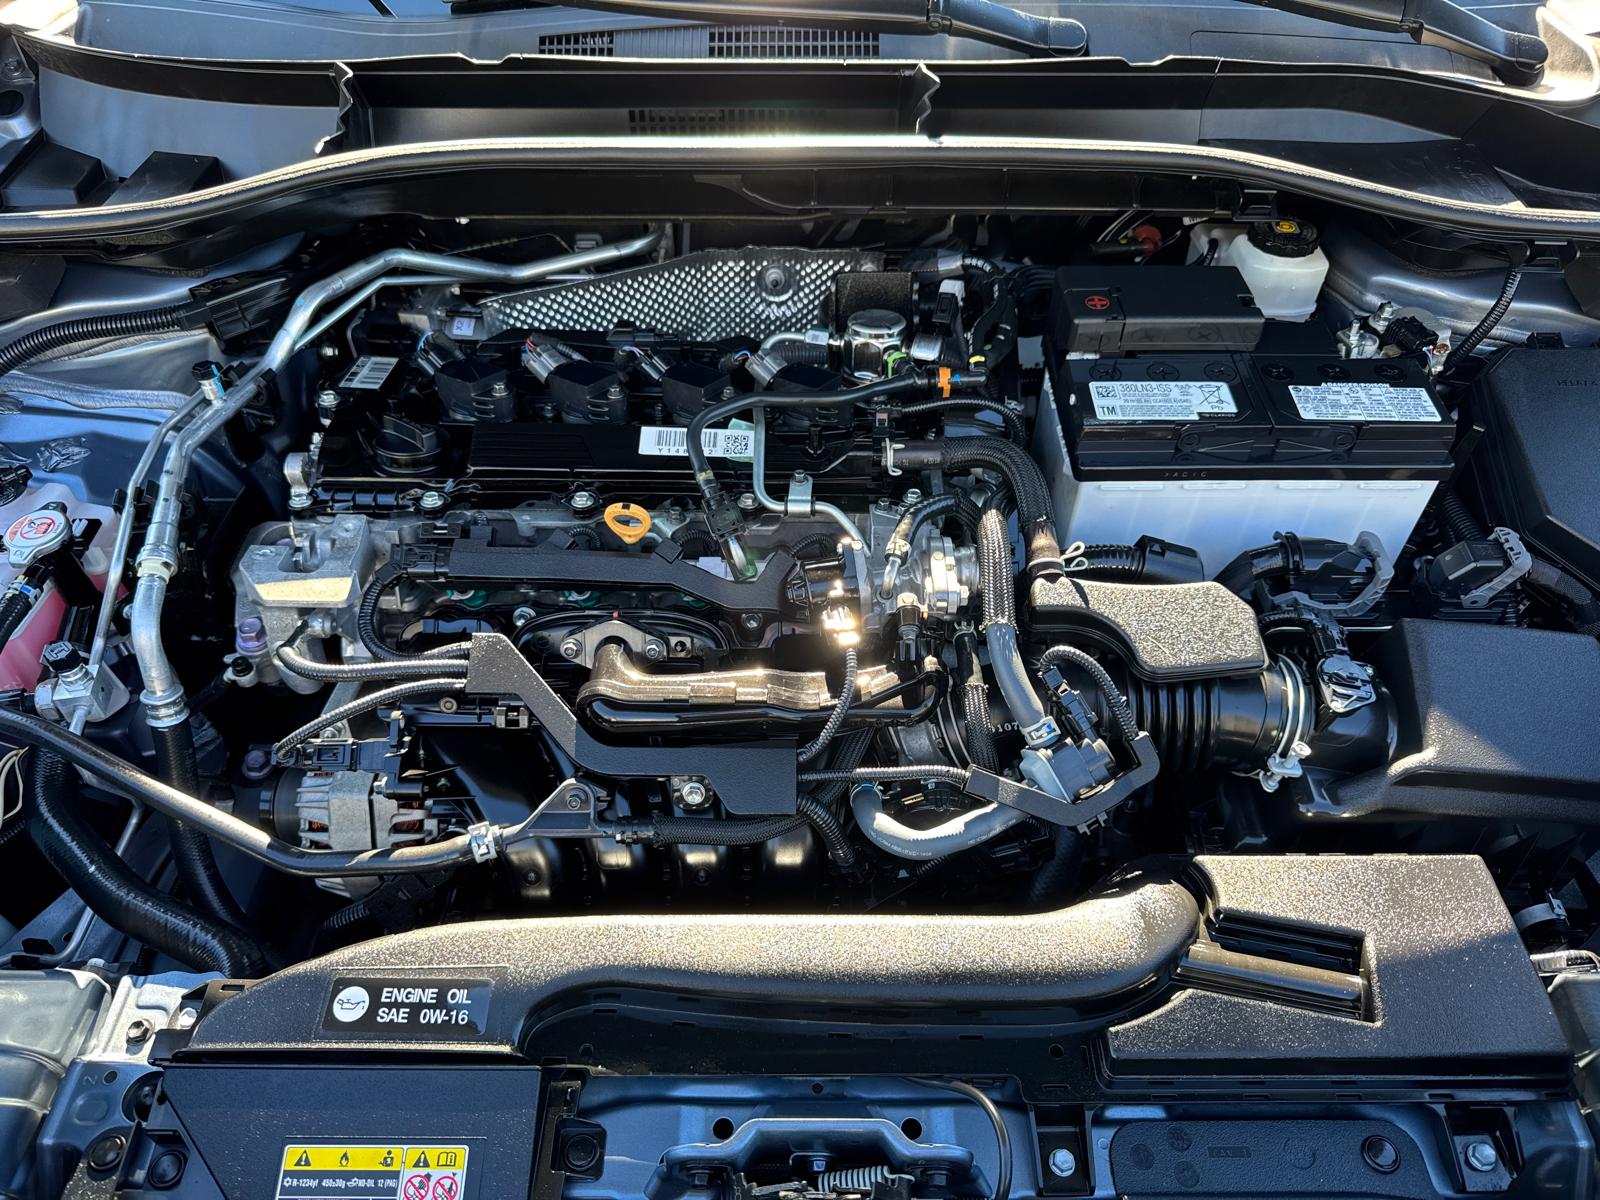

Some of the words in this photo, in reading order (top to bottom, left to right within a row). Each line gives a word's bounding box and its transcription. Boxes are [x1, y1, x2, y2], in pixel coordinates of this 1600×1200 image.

[1119, 383, 1172, 393] 380LN3-ISS
[1100, 406, 1117, 416] TM
[381, 987, 438, 1004] ENGINE
[447, 988, 472, 1004] OIL
[376, 1007, 410, 1023] SAE
[419, 1009, 468, 1025] 0W-16
[292, 1178, 319, 1189] R-1234yf
[321, 1178, 346, 1189] 450±30g
[377, 1179, 384, 1187] 12
[384, 1179, 398, 1189] (PAG)
